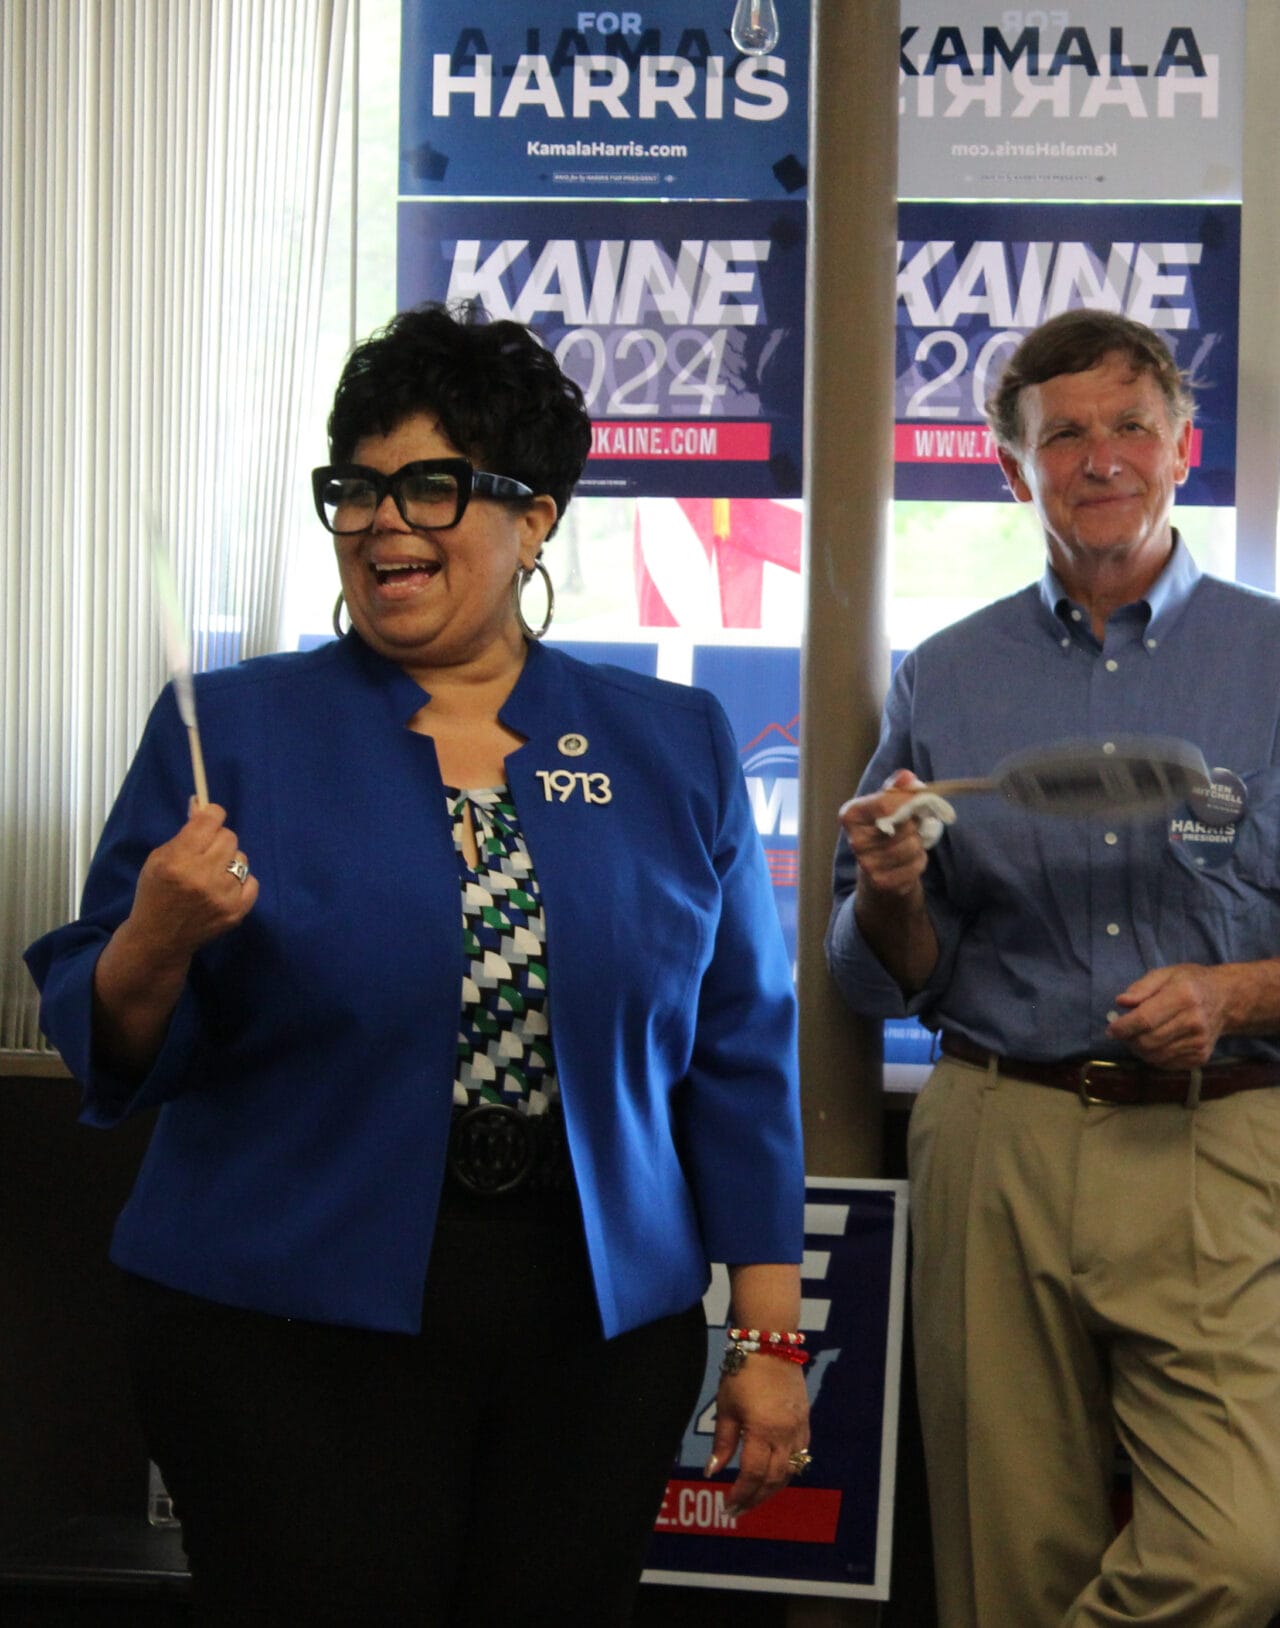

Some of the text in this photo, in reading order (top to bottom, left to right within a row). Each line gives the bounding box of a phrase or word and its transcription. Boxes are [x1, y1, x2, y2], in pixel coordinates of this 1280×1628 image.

[577, 12, 642, 34] FOR
[432, 53, 790, 121] HARRIS
[527, 140, 688, 158] KamalaHarris.com
[446, 240, 771, 325] KAINE
[550, 328, 728, 416] 024
[536, 769, 612, 804] 1913
